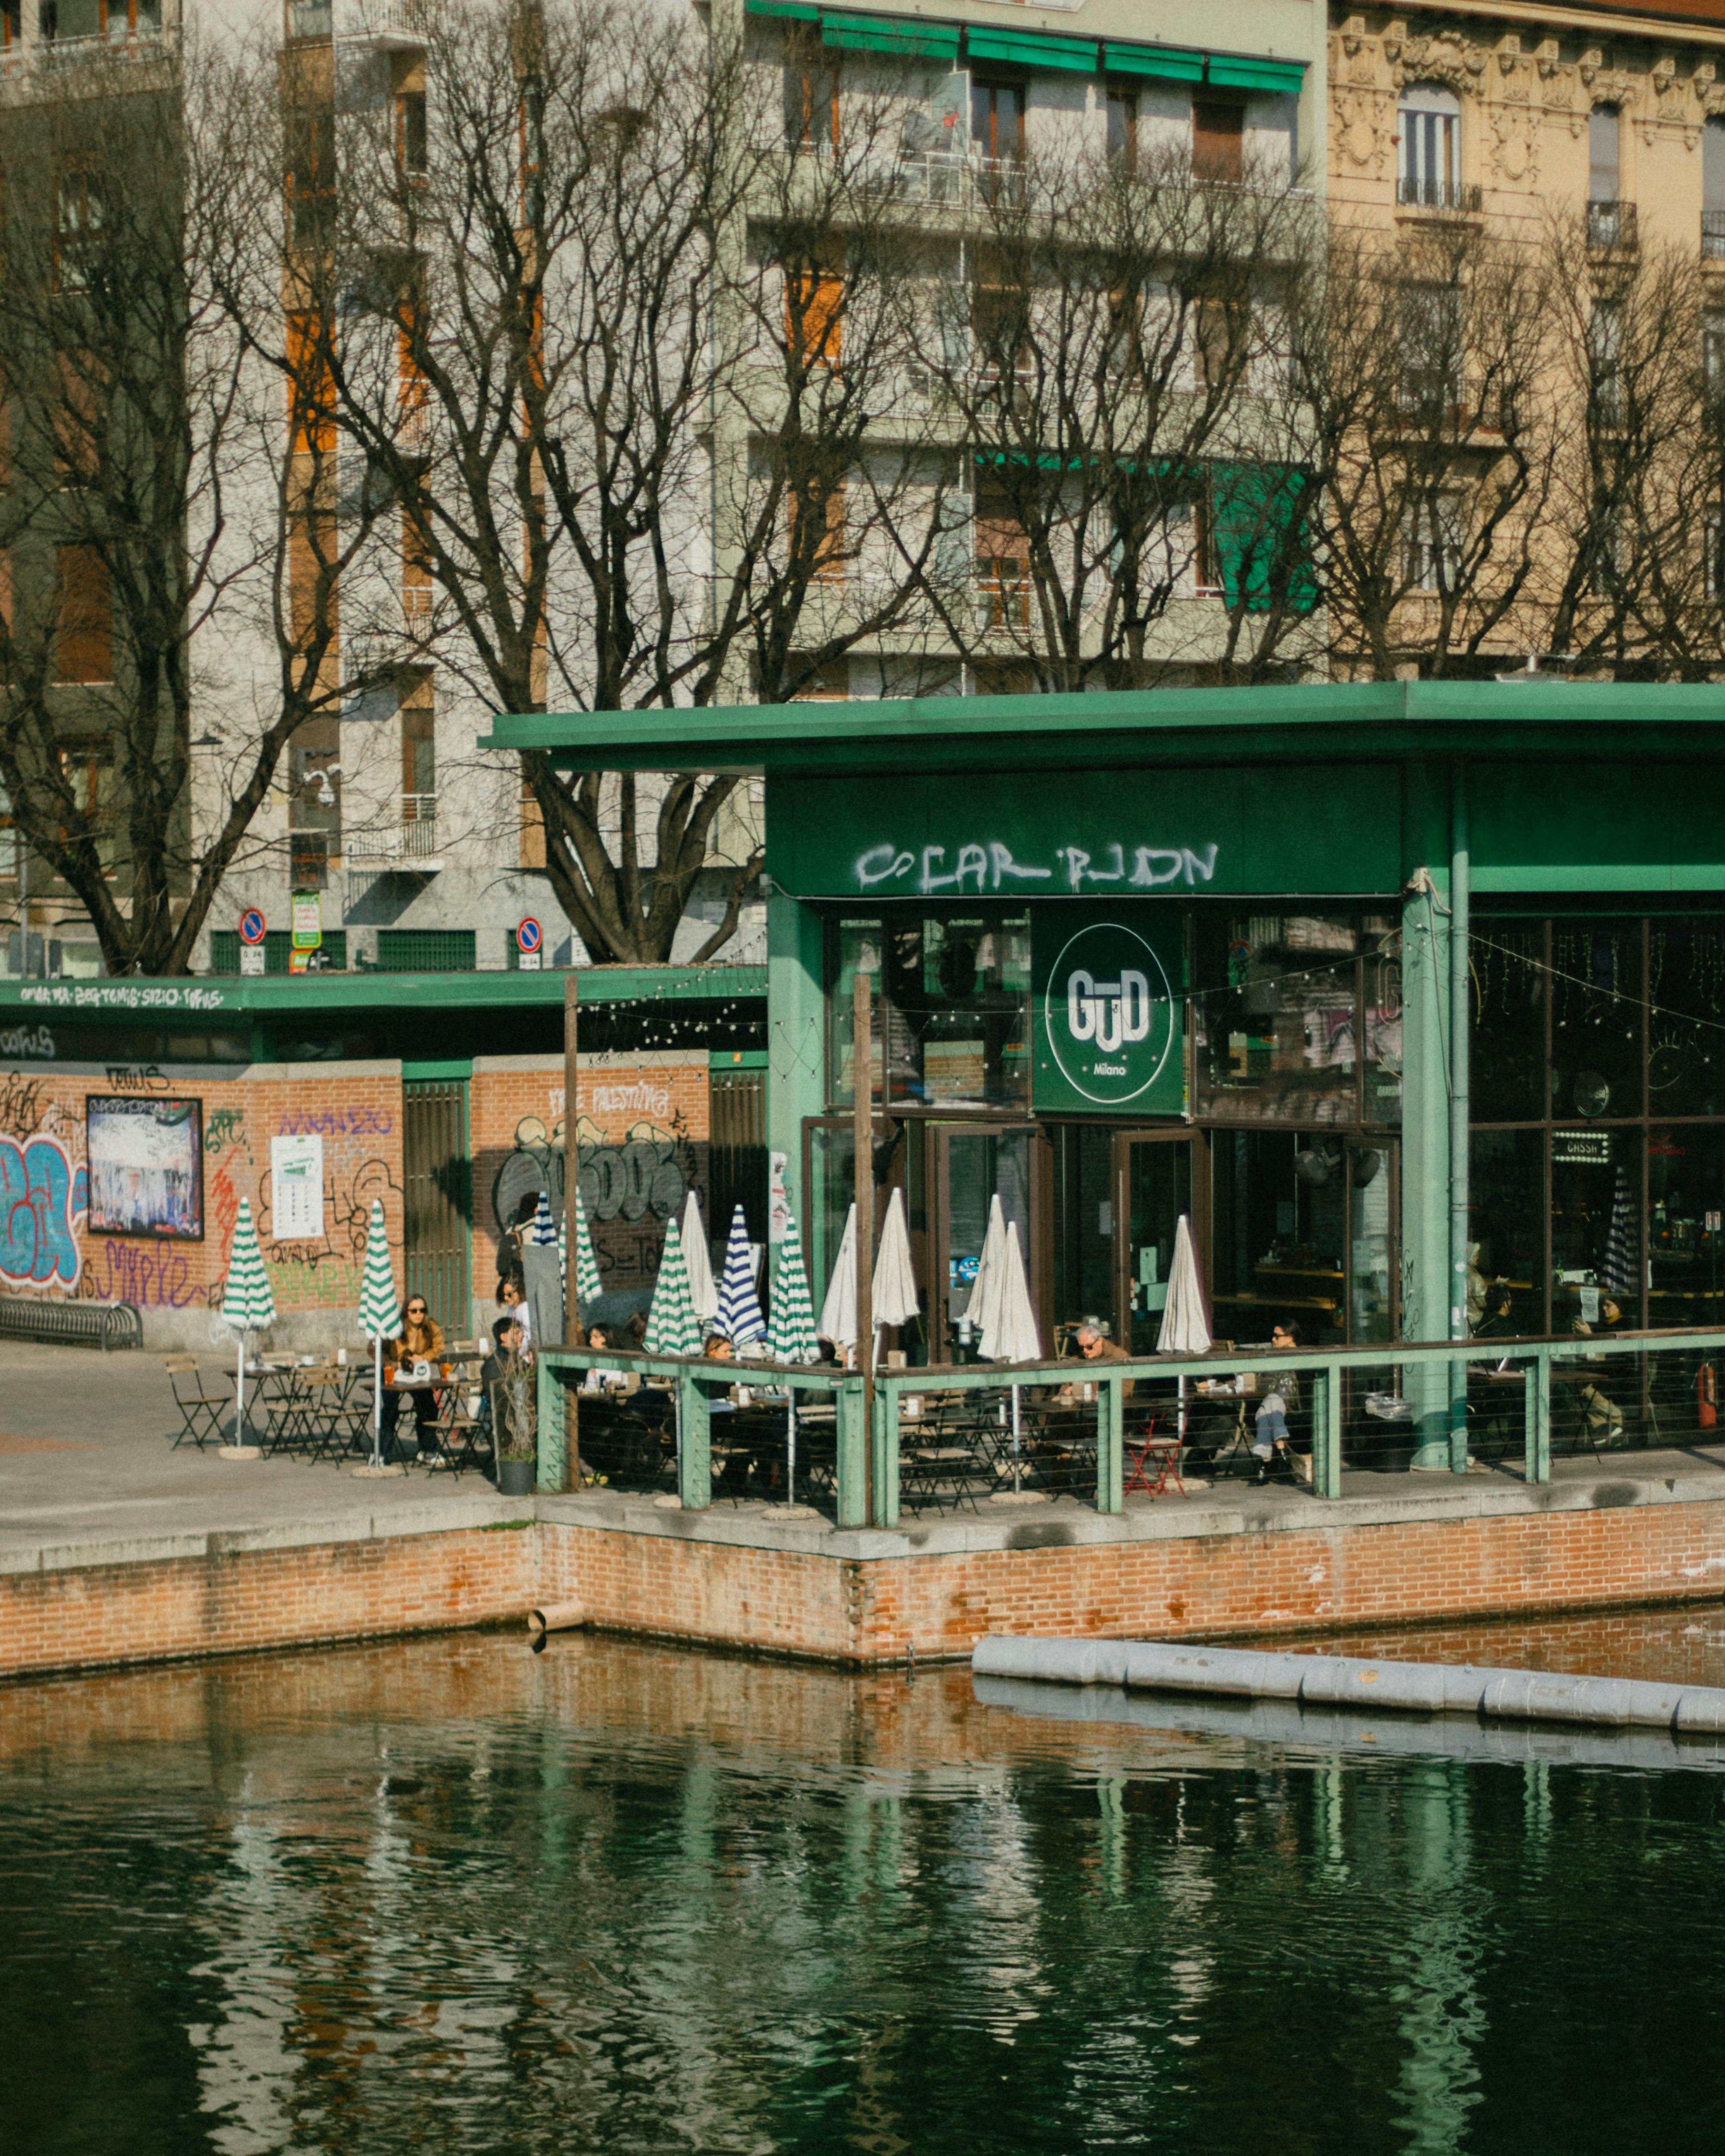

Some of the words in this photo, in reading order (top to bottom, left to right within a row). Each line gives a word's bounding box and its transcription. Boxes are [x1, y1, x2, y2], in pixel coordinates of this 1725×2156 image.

[1068, 970, 1148, 1052] GUD
[1093, 1062, 1126, 1076] Milano
[1567, 1141, 1597, 1154] CASSA
